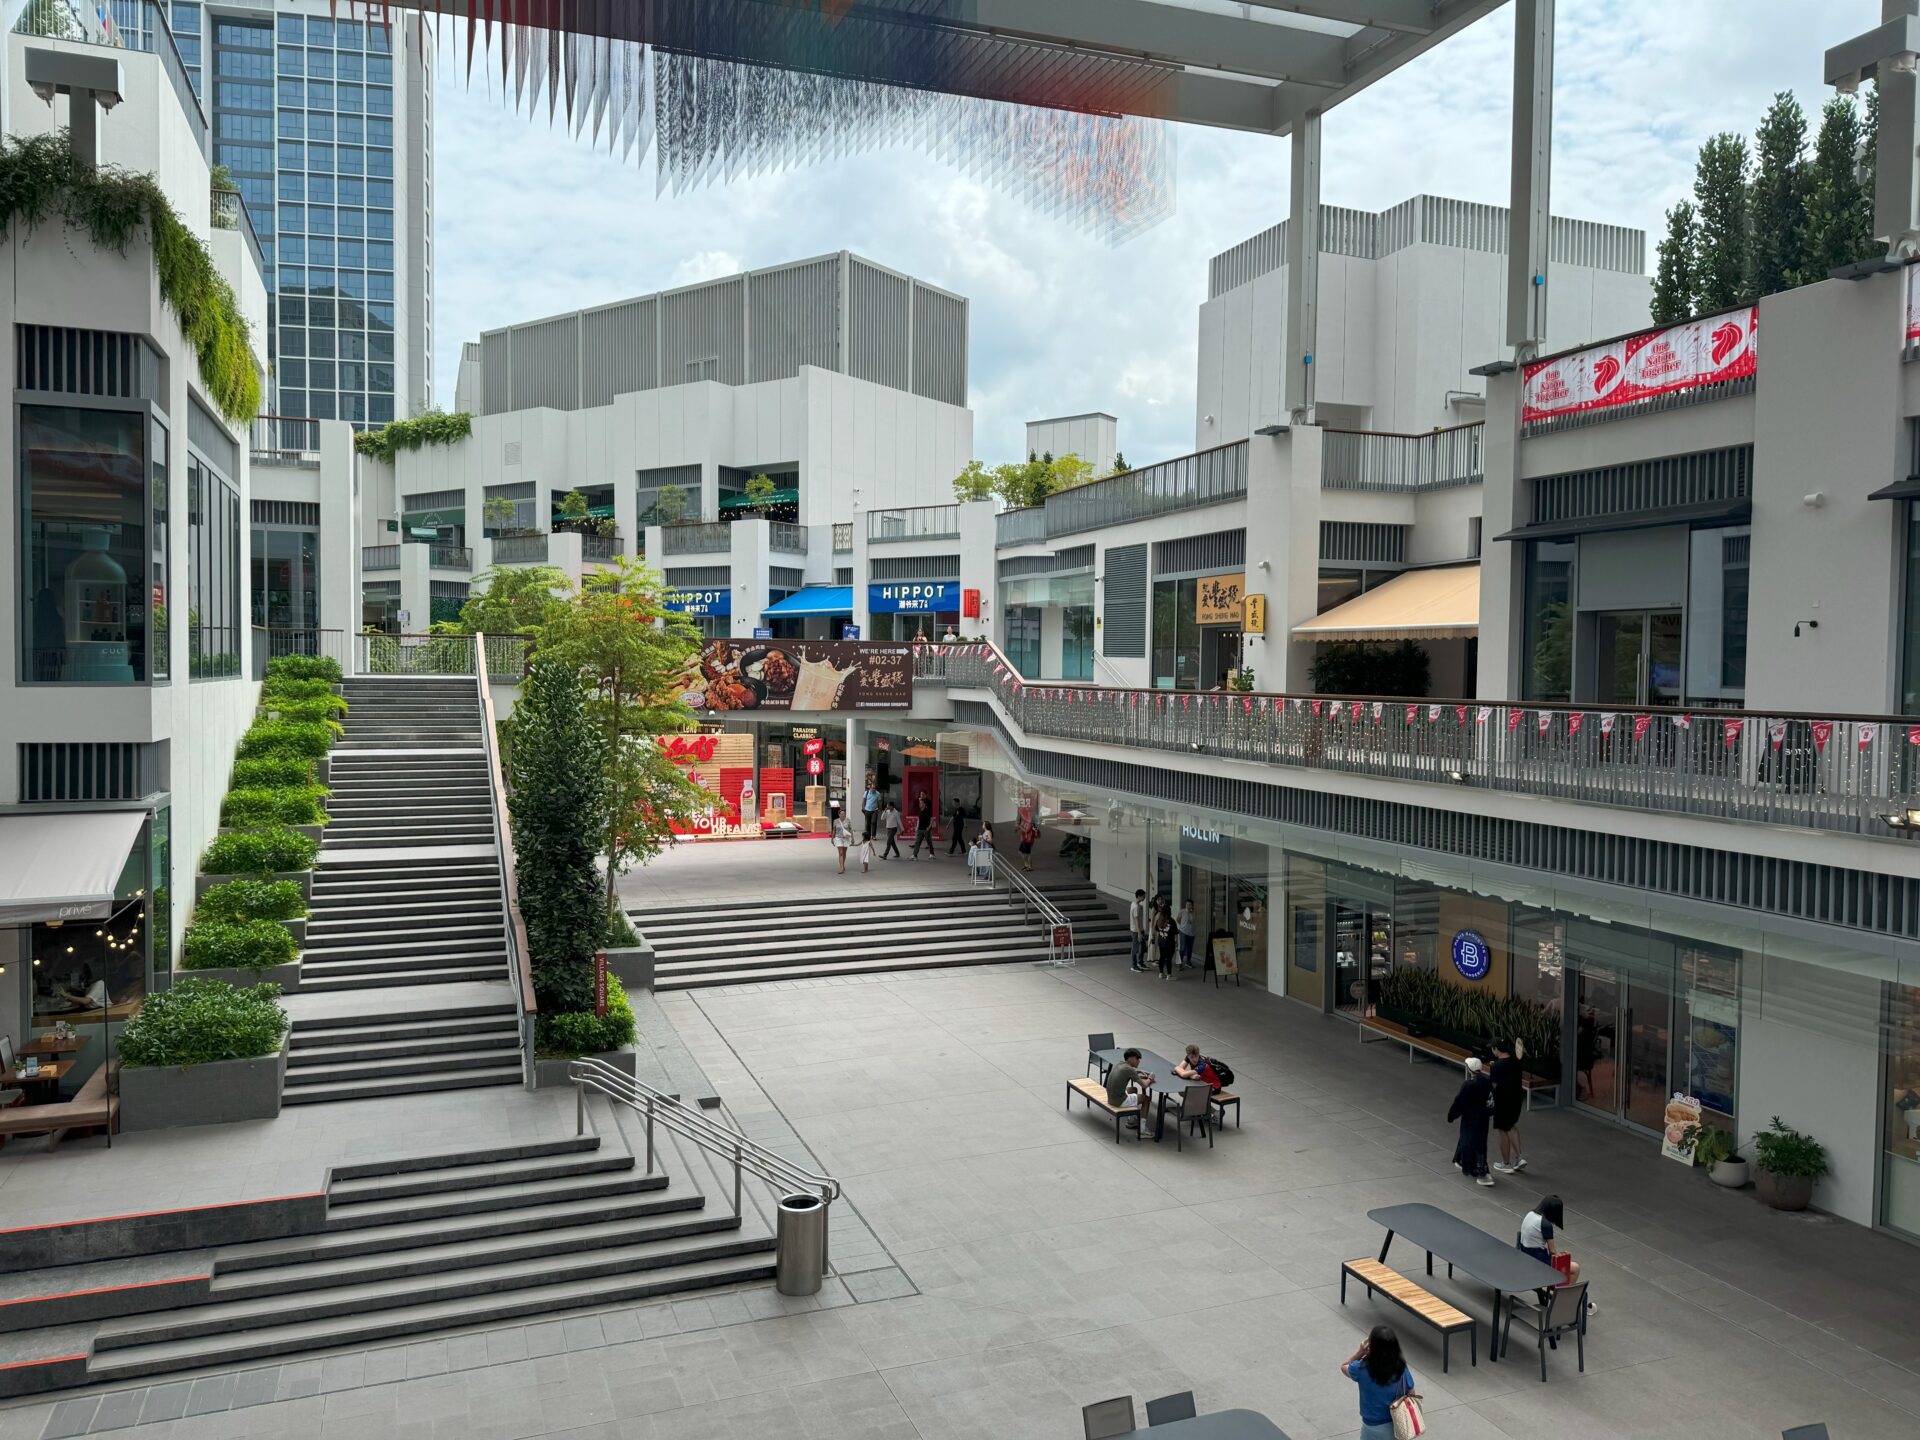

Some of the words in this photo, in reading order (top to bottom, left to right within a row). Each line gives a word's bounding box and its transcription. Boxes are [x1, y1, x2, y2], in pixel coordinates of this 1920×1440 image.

[1652, 342, 1670, 354] One
[1646, 351, 1676, 367] Nation
[1545, 370, 1560, 381] One
[1639, 360, 1681, 379] Together
[883, 585, 944, 599] HIPPOT
[869, 656, 902, 664] #02-37
[692, 817, 726, 829] YOUR
[711, 823, 762, 834] DREAMS
[1183, 825, 1220, 844] HOLLIN
